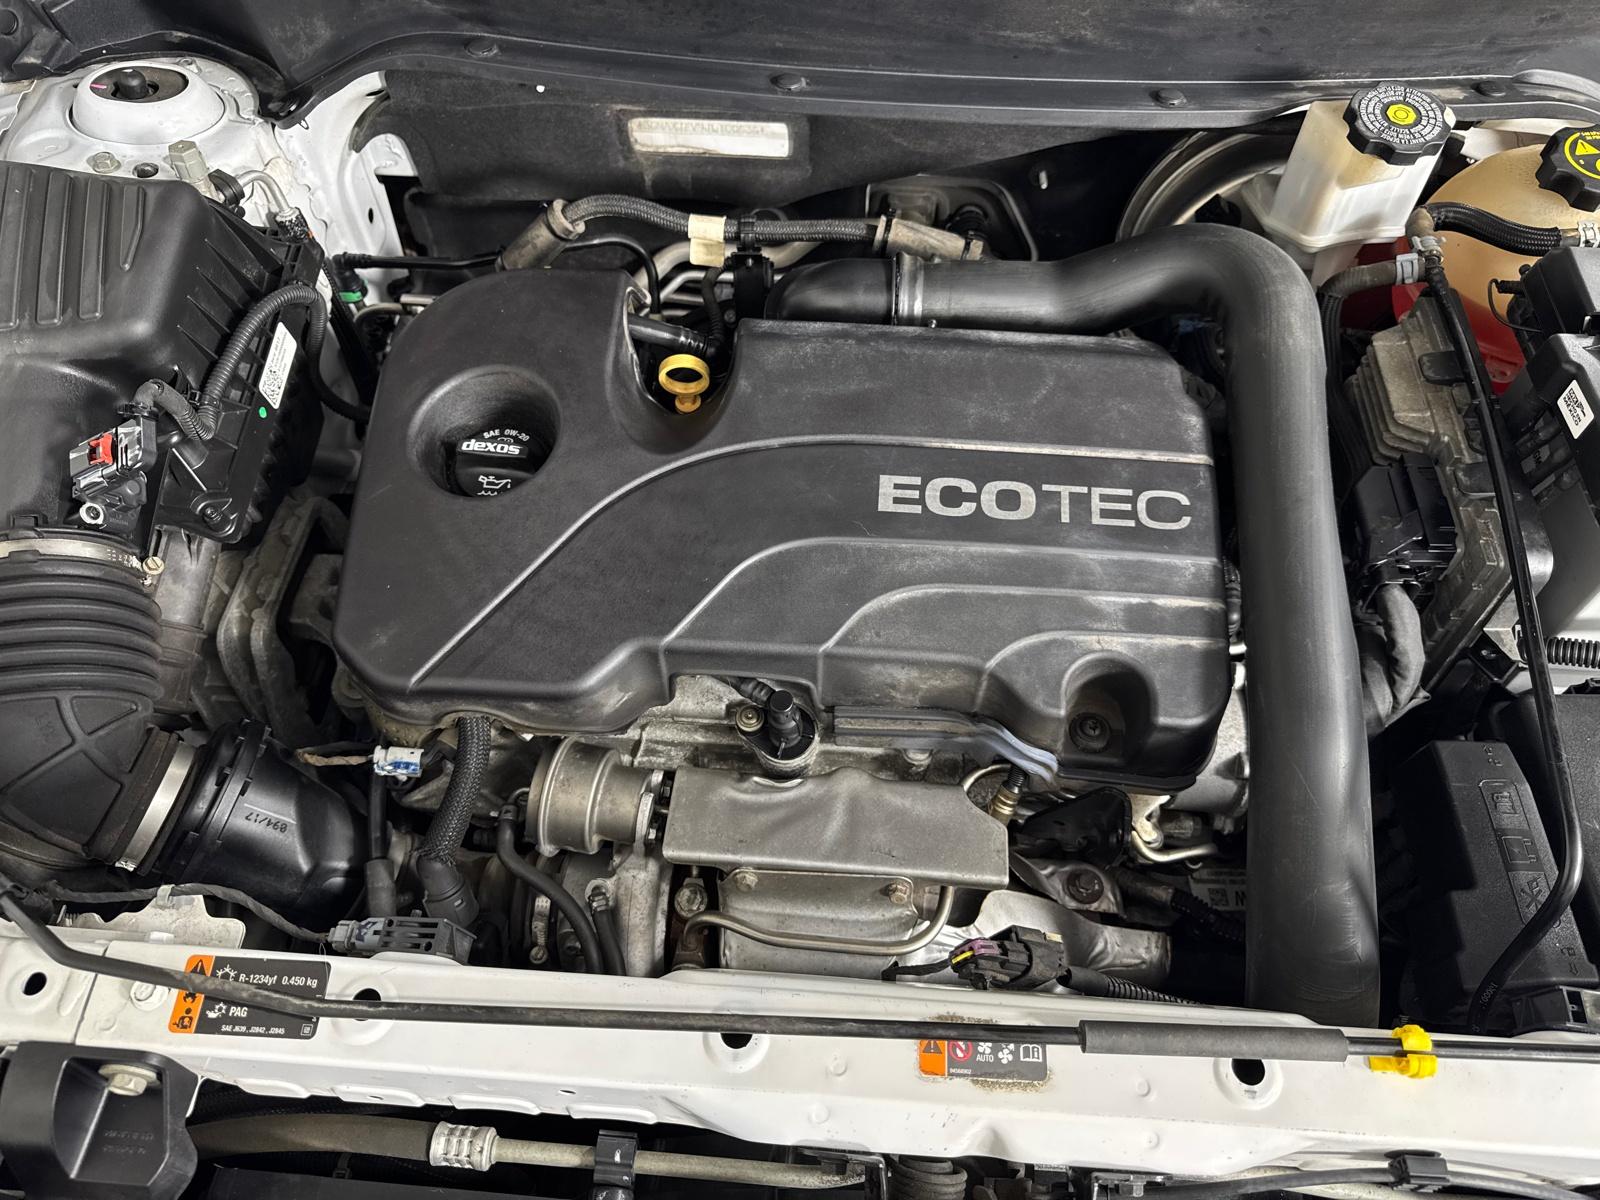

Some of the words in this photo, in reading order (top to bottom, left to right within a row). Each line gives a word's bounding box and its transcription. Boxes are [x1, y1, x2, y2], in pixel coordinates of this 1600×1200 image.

[483, 429, 500, 439] SAE
[504, 429, 530, 441] 0W-20
[461, 439, 523, 455] dexos
[878, 475, 1192, 530] ECOTEC
[239, 974, 277, 985] R-1234yf
[282, 976, 305, 986] 0.450
[307, 977, 317, 988] kg
[229, 1006, 248, 1018] PAG
